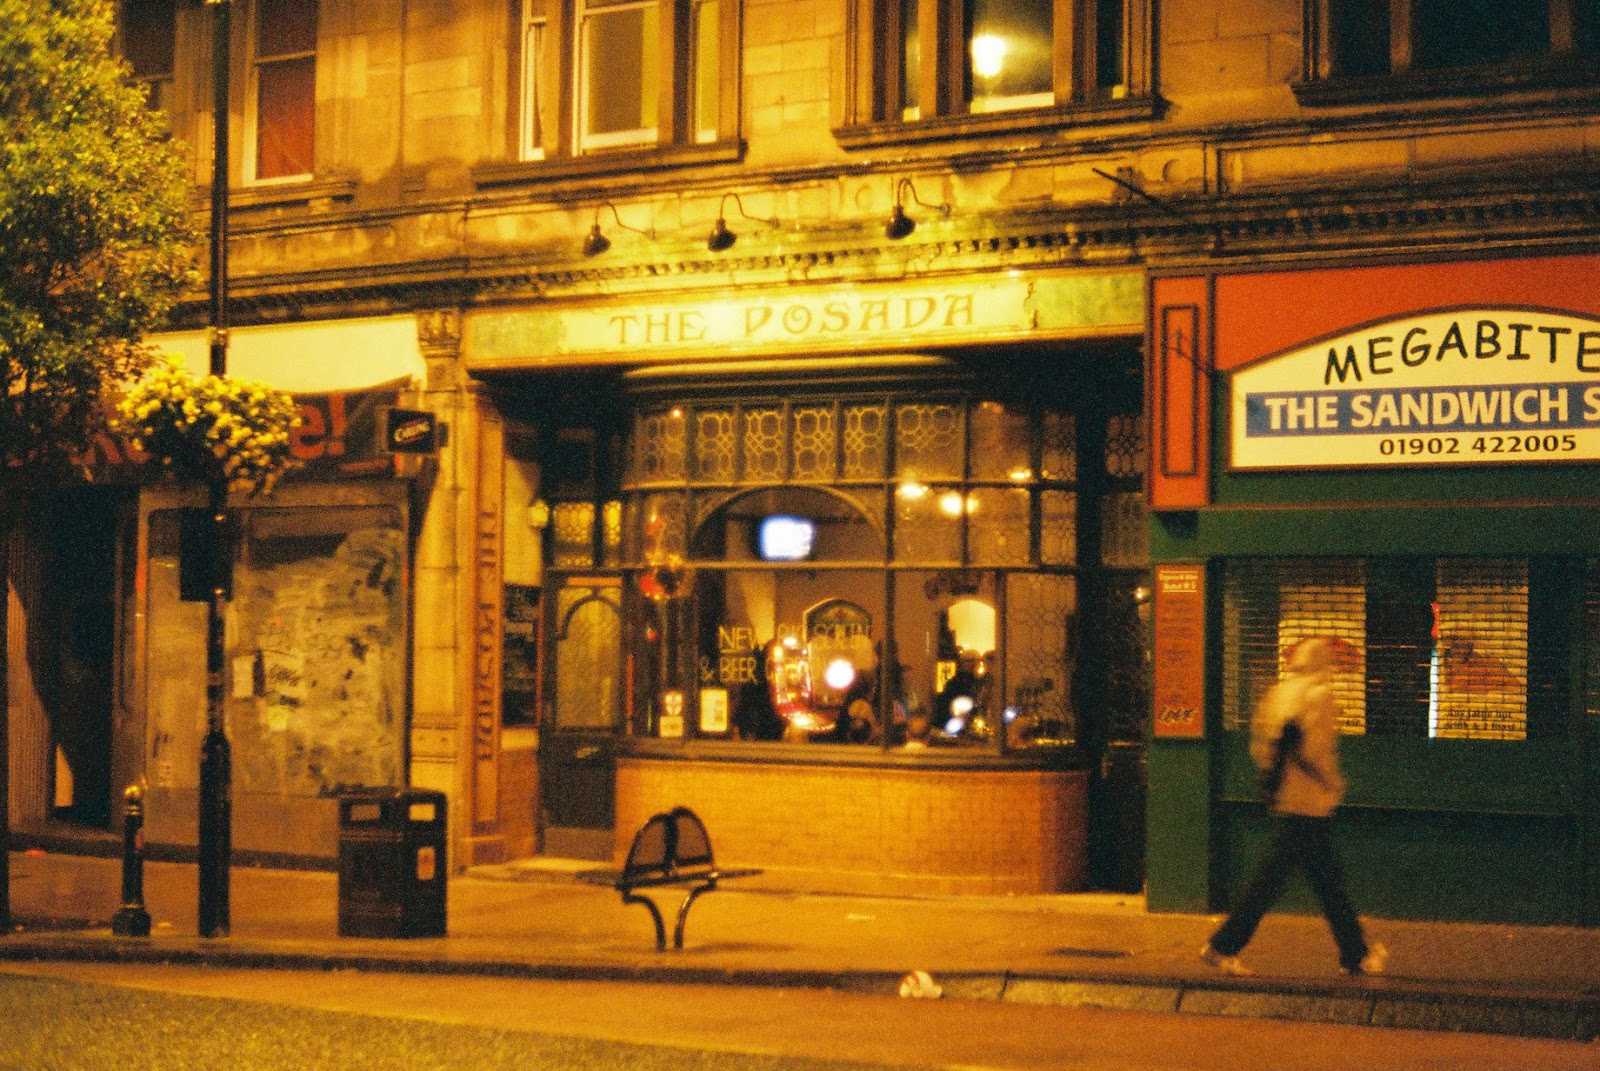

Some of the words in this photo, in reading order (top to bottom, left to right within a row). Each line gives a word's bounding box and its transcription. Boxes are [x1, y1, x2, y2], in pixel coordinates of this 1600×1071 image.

[609, 312, 705, 345] THE
[744, 293, 976, 337] POSADA
[1324, 321, 1600, 385] MEGABITE
[1265, 395, 1338, 430] THE
[1351, 388, 1568, 427] SANDWICH
[1379, 437, 1460, 455] 01902
[1471, 434, 1577, 453] 422005
